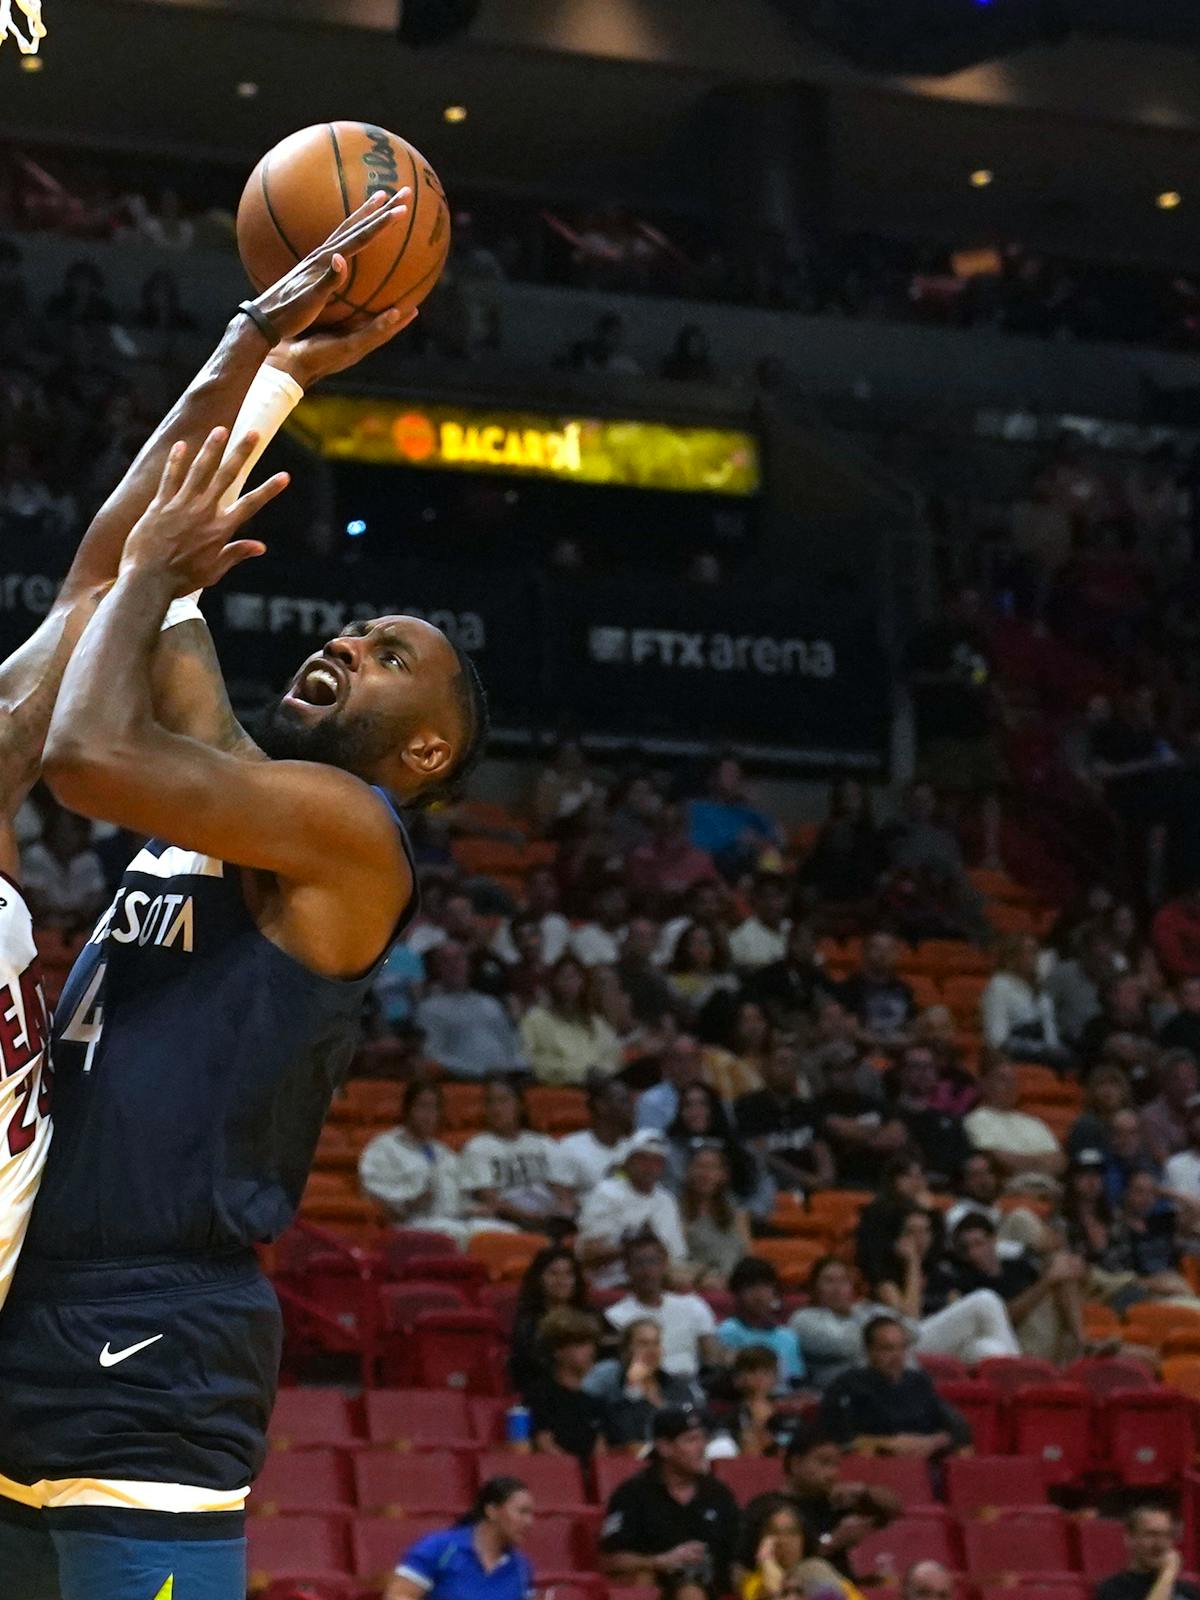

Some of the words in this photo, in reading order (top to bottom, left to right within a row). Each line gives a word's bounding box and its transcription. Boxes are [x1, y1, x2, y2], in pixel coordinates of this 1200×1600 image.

[268, 595, 346, 634] FTX
[631, 629, 703, 668] FTX
[708, 632, 836, 679] arena
